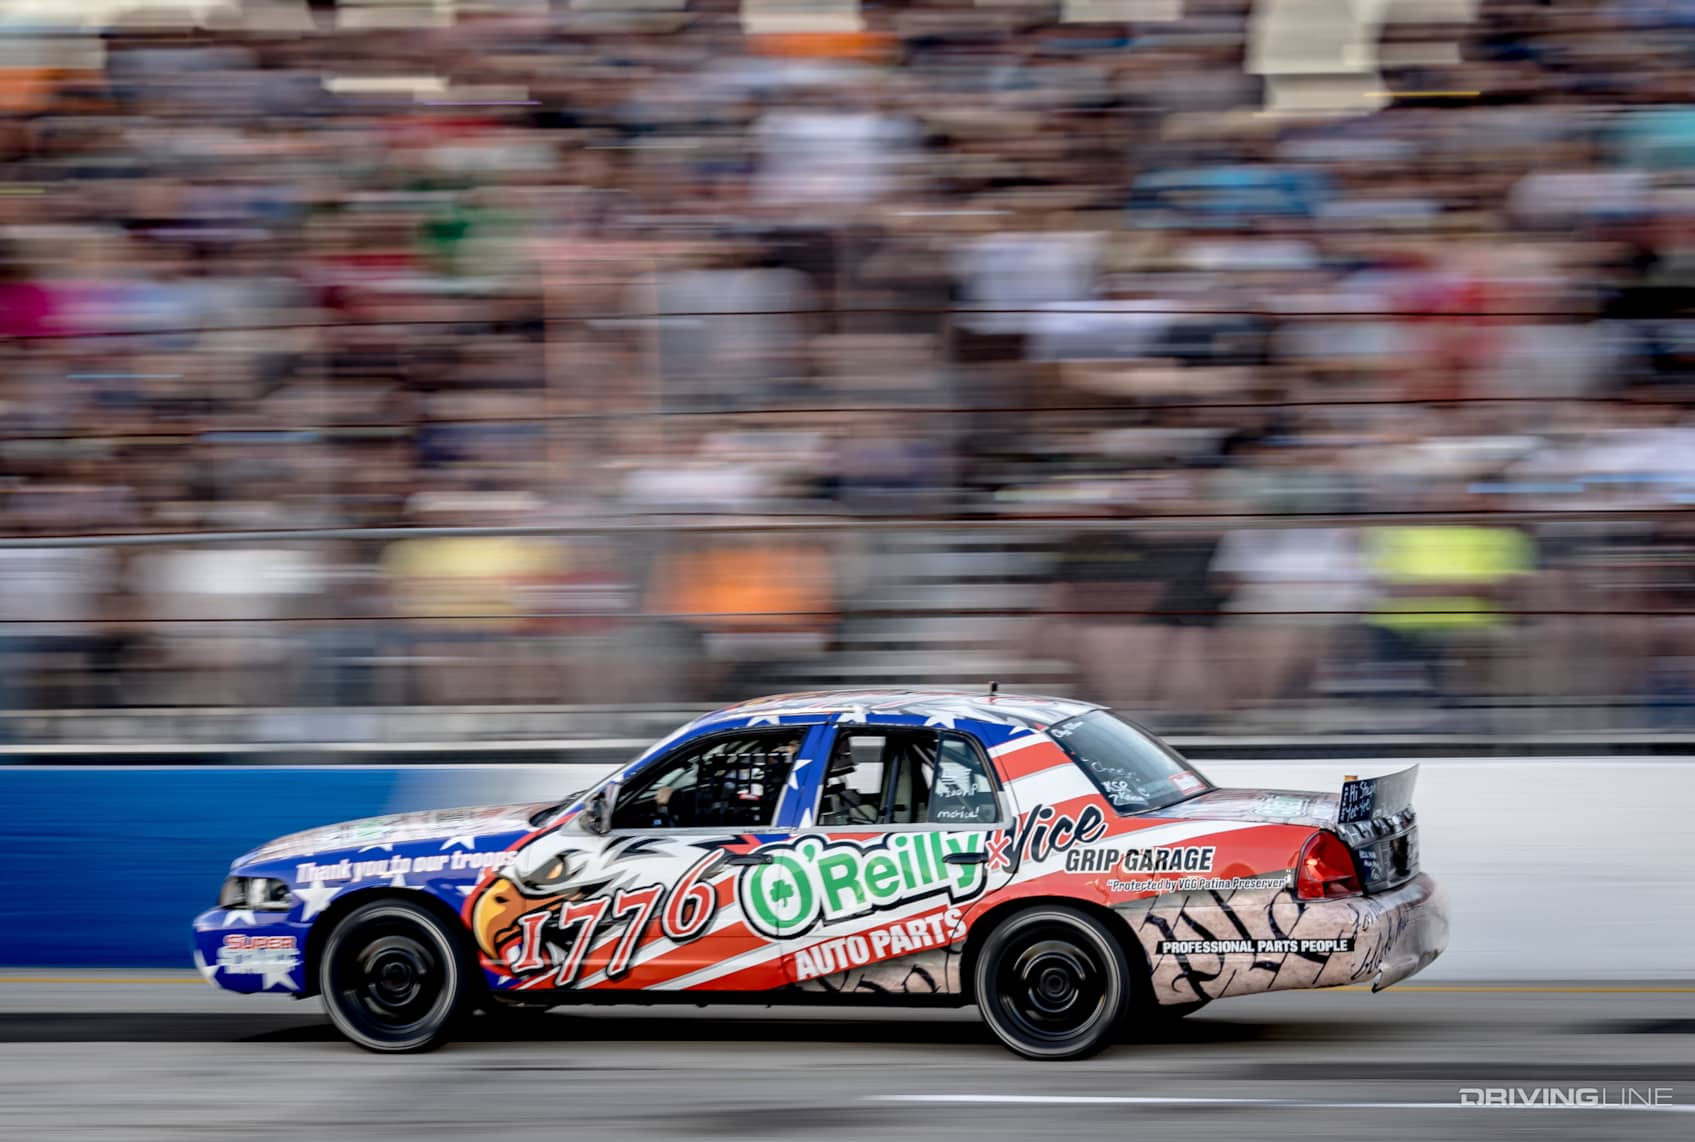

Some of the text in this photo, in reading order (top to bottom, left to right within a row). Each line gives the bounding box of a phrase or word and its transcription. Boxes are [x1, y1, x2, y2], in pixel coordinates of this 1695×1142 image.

[296, 859, 352, 883] Thank
[412, 855, 449, 873] our
[451, 850, 519, 871] troops
[1064, 847, 1215, 873] GRIP GARAGE
[748, 831, 985, 929] O'Reilly
[1165, 880, 1176, 892] by
[1178, 879, 1197, 890] VGG
[1199, 878, 1231, 890] Patina
[511, 847, 726, 987] 1776
[794, 908, 967, 981] AUTO PARTS
[1162, 939, 1347, 953] PROFESSIONAL PARTS PEOPLE
